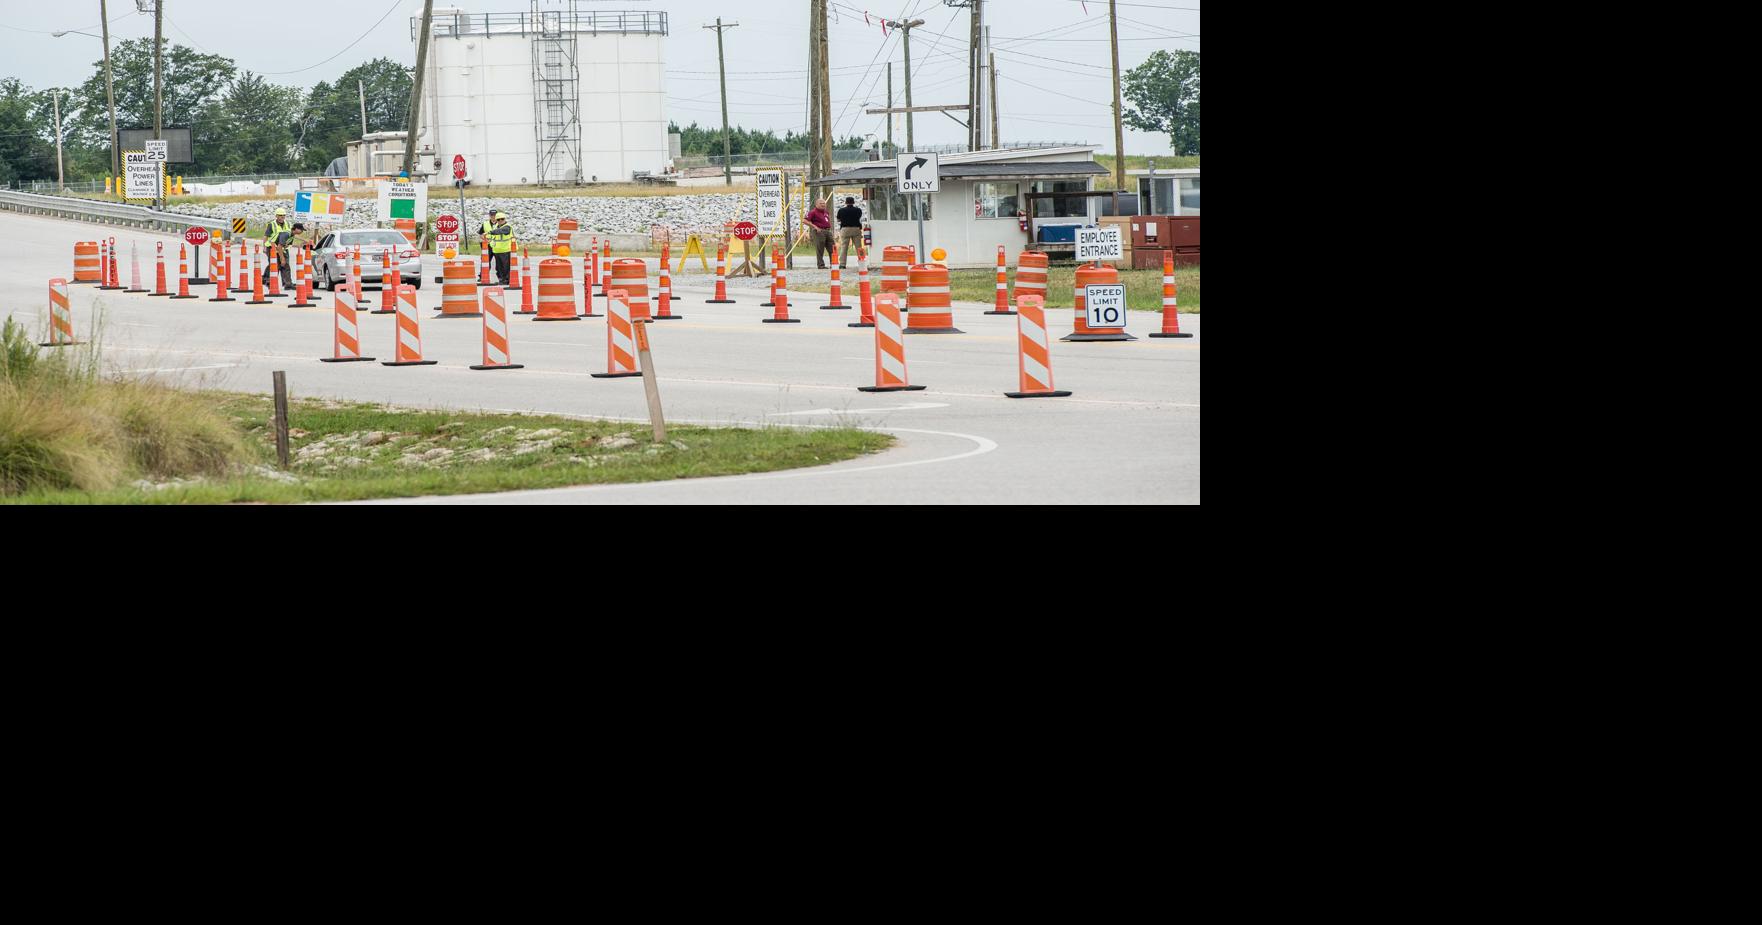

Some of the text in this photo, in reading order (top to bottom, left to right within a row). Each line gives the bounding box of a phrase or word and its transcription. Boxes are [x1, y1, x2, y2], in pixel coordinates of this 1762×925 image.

[148, 152, 166, 160] 25
[759, 174, 780, 184] CAUTION
[903, 181, 933, 190] ONLY
[759, 190, 780, 198] OVERHEAD
[763, 200, 777, 208] POWER
[764, 210, 776, 218] LINES
[735, 227, 756, 235] STOP
[1081, 232, 1117, 243] EMPLOYEE
[1080, 245, 1119, 257] ENTRANCE
[1093, 307, 1119, 323] 10
